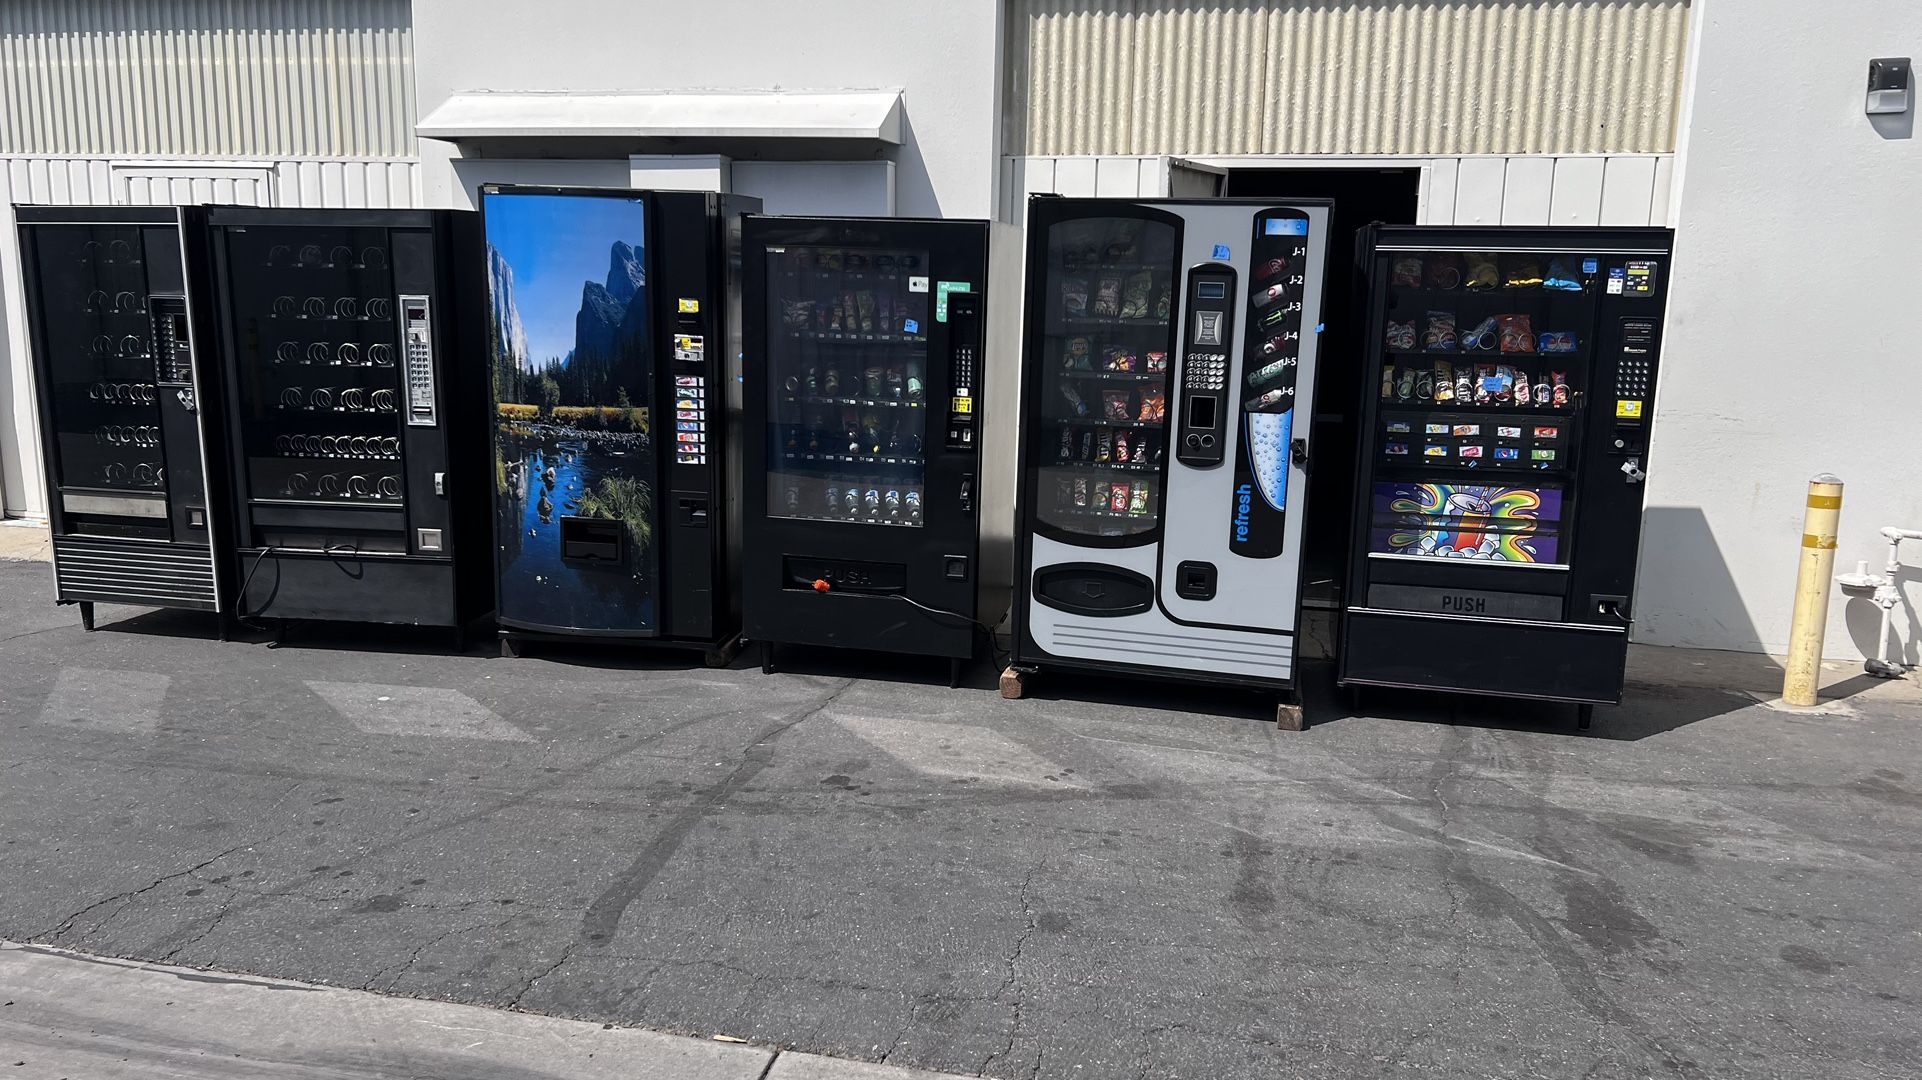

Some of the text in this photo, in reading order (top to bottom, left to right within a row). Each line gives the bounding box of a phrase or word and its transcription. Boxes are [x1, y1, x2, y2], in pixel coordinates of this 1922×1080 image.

[1292, 247, 1306, 256] J-1
[1289, 275, 1303, 285] J-2
[1287, 302, 1301, 311] J-3
[1284, 331, 1298, 340] J-4
[1283, 357, 1297, 366] J-5
[1280, 386, 1294, 396] J-6
[1234, 484, 1251, 542] refresh
[1441, 596, 1486, 613] PUSH
